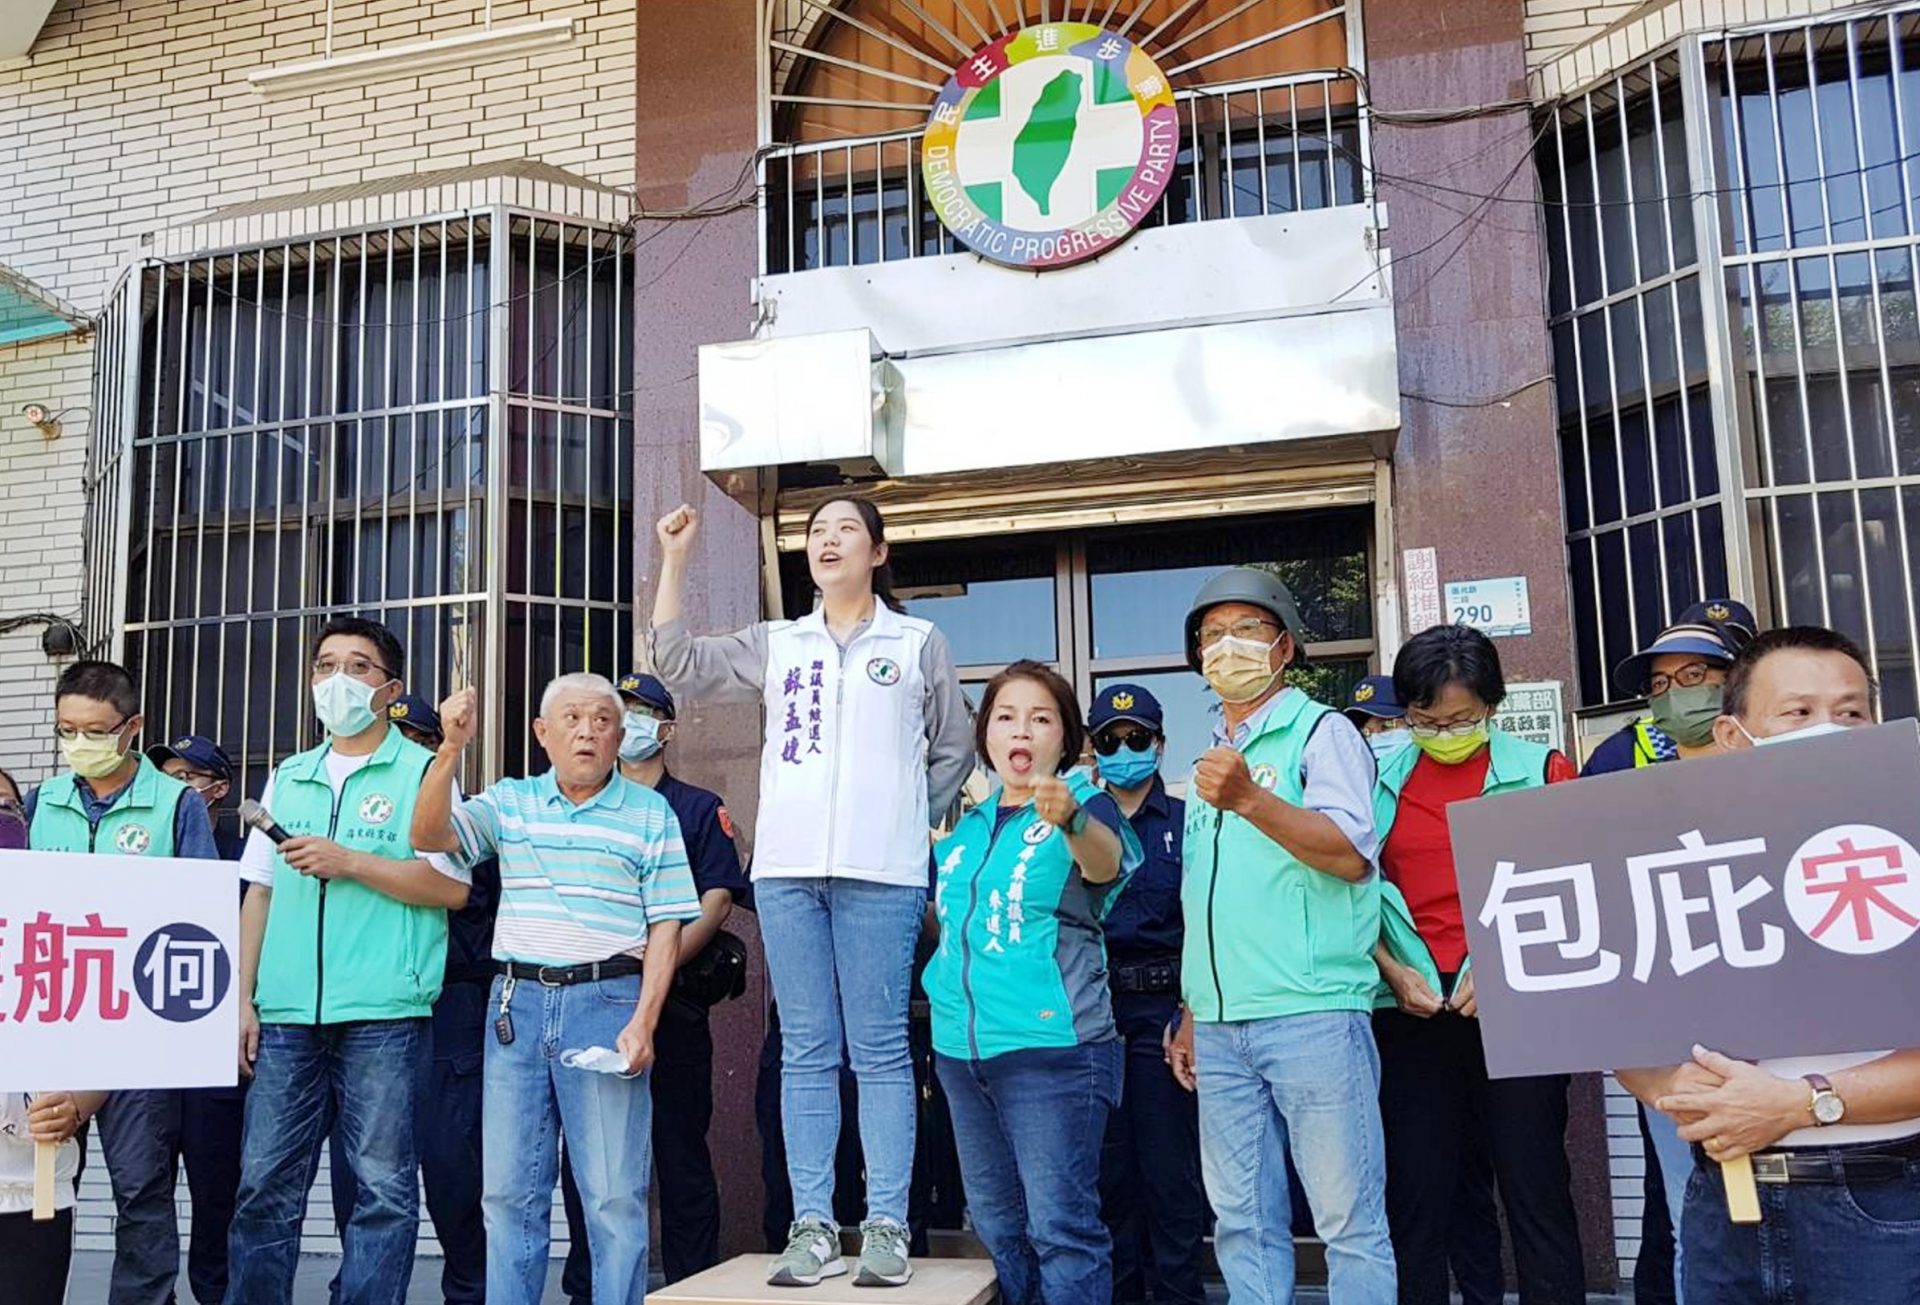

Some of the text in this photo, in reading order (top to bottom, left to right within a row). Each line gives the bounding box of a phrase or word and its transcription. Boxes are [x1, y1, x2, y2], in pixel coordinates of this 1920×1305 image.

[934, 28, 1164, 125] 民主進步黨
[928, 118, 1173, 261] DEMOCRATIC PROGRESSIVE PARTY
[1454, 604, 1492, 626] 290
[807, 660, 824, 754] 縣議員候選人
[1492, 715, 1551, 732] 疫政策
[1478, 829, 1920, 992] 包庇宋
